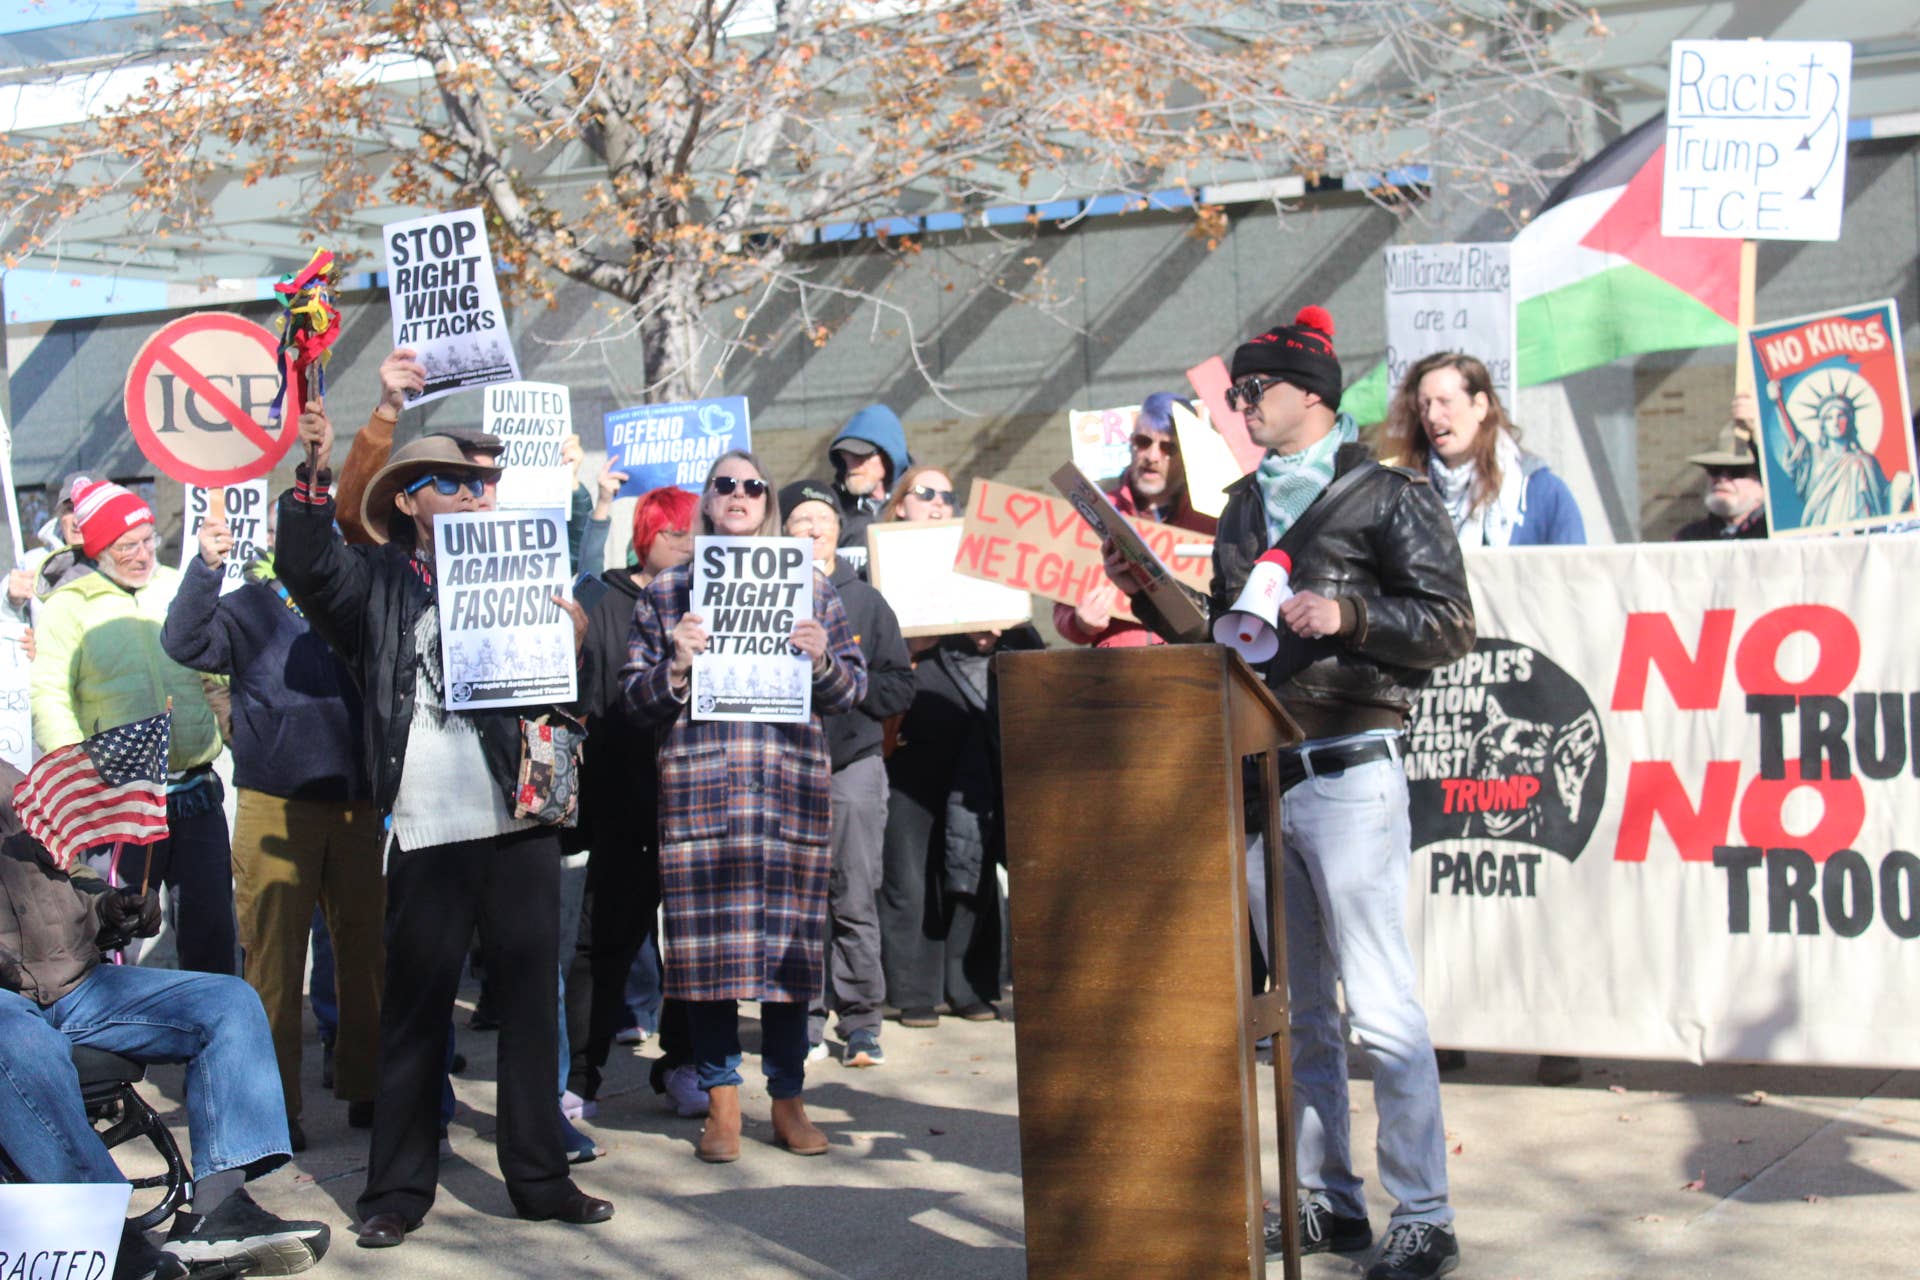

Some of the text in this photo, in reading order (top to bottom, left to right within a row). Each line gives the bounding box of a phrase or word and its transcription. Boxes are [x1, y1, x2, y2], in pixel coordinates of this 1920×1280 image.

[1678, 50, 1823, 113] Racist
[1668, 125, 1779, 186] Trump
[391, 221, 476, 266] STOP
[396, 256, 481, 295] RIGHT
[1467, 247, 1511, 289] Police
[404, 285, 479, 320] WING
[1414, 308, 1468, 331] are a
[399, 310, 496, 345] ATTACKS
[1766, 321, 1886, 372] NO KINGS
[153, 374, 281, 433] ICE
[493, 390, 563, 415] UNITED
[491, 417, 566, 436] AGAINST
[612, 416, 684, 446] DEFEND
[497, 440, 564, 467] ASCISM
[624, 434, 733, 466] IMMIGRANT
[191, 486, 260, 515] SOP
[443, 518, 557, 556] UNITED
[446, 552, 562, 586] AGAINST
[703, 545, 804, 580] STOP
[450, 583, 564, 631] FASCISM
[702, 581, 804, 607] RIGHT
[712, 608, 794, 634] WING
[1432, 647, 1534, 687] EOPLE'S
[1611, 604, 1861, 711] NO
[1440, 775, 1541, 814] TRUMP
[1614, 758, 1867, 863] NO
[1430, 850, 1542, 898] PACAT
